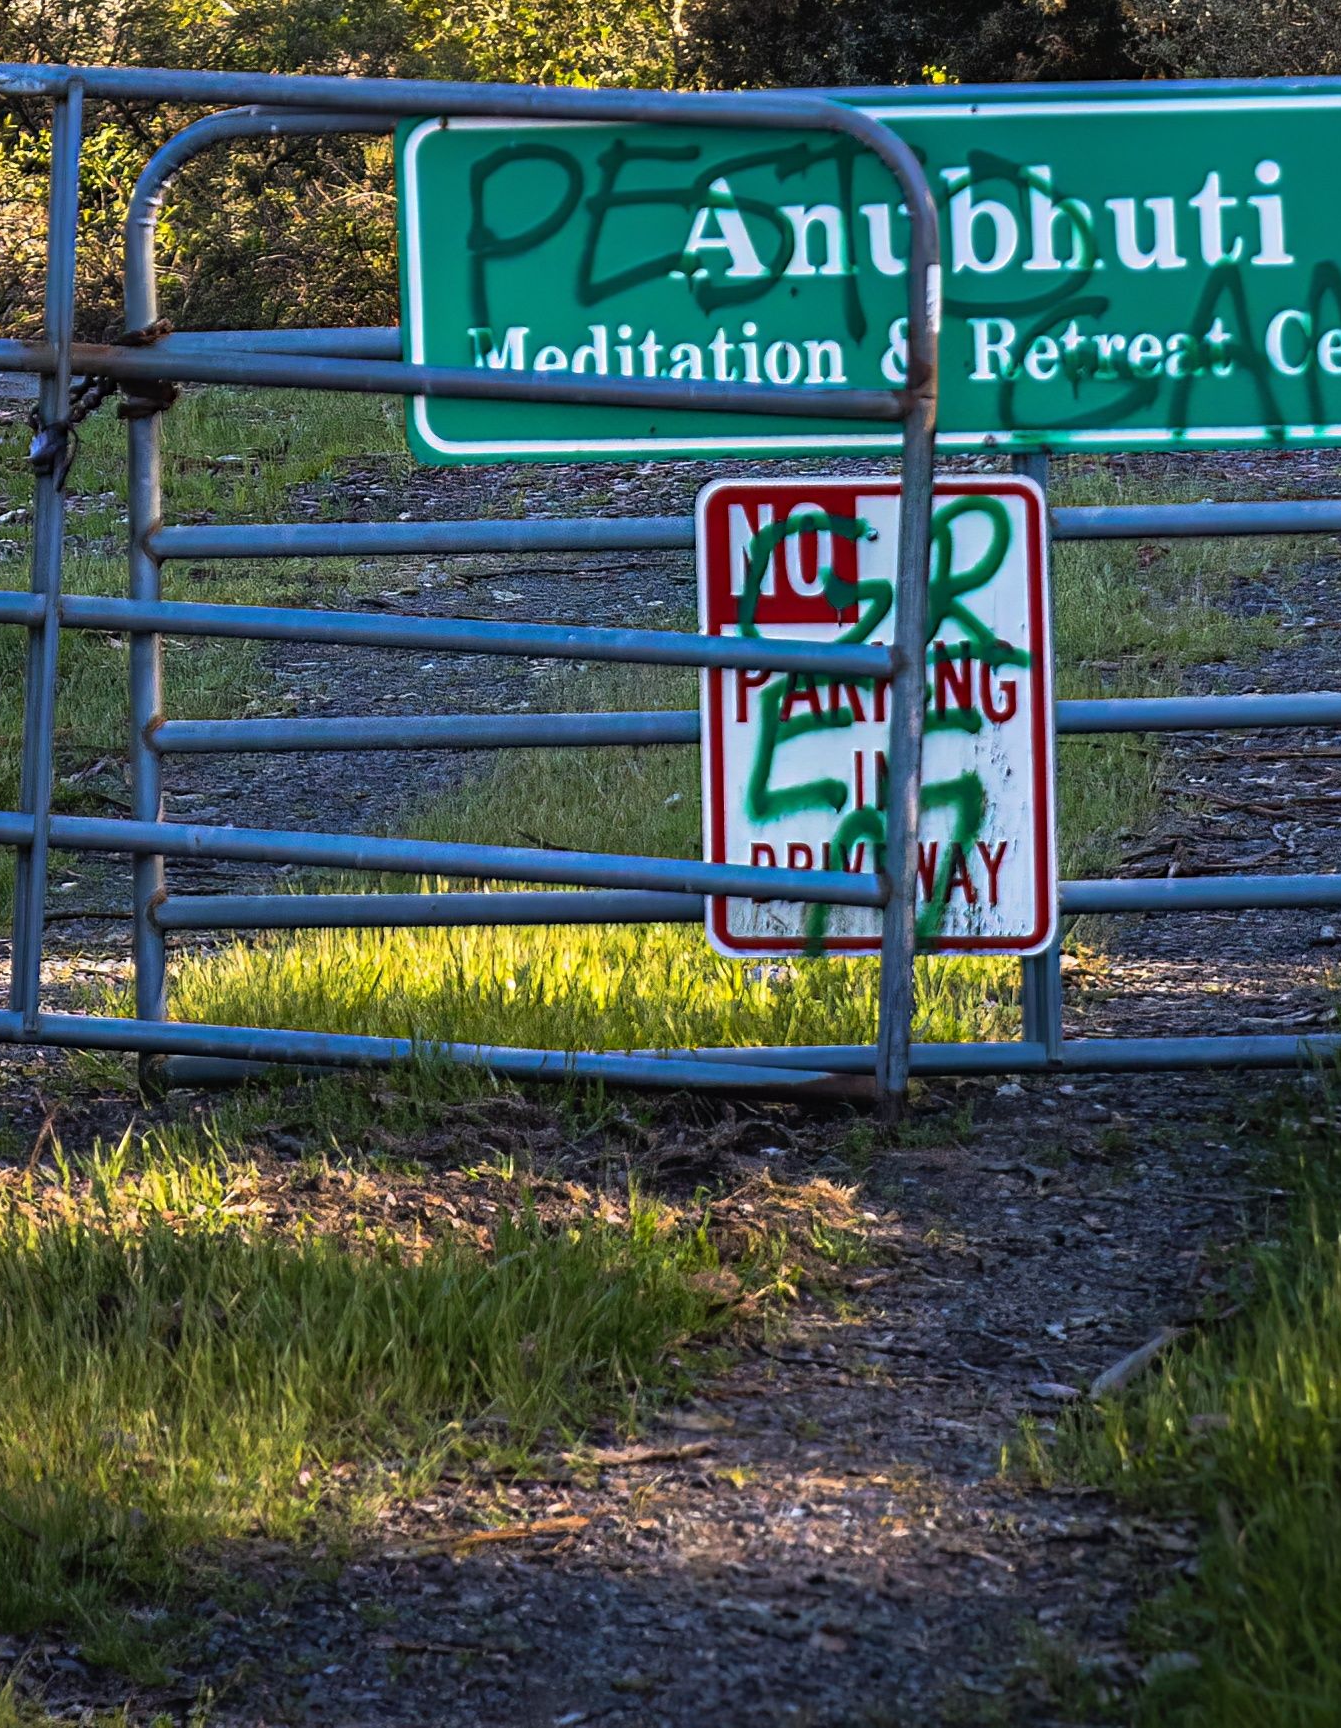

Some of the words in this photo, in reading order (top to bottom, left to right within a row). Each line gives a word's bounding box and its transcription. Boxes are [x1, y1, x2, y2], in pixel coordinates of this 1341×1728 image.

[668, 159, 1295, 278] Anubhuti
[468, 321, 848, 385] Meditation
[967, 315, 1234, 381] Retreat
[727, 501, 837, 598] NO
[735, 640, 1017, 725] PARNG
